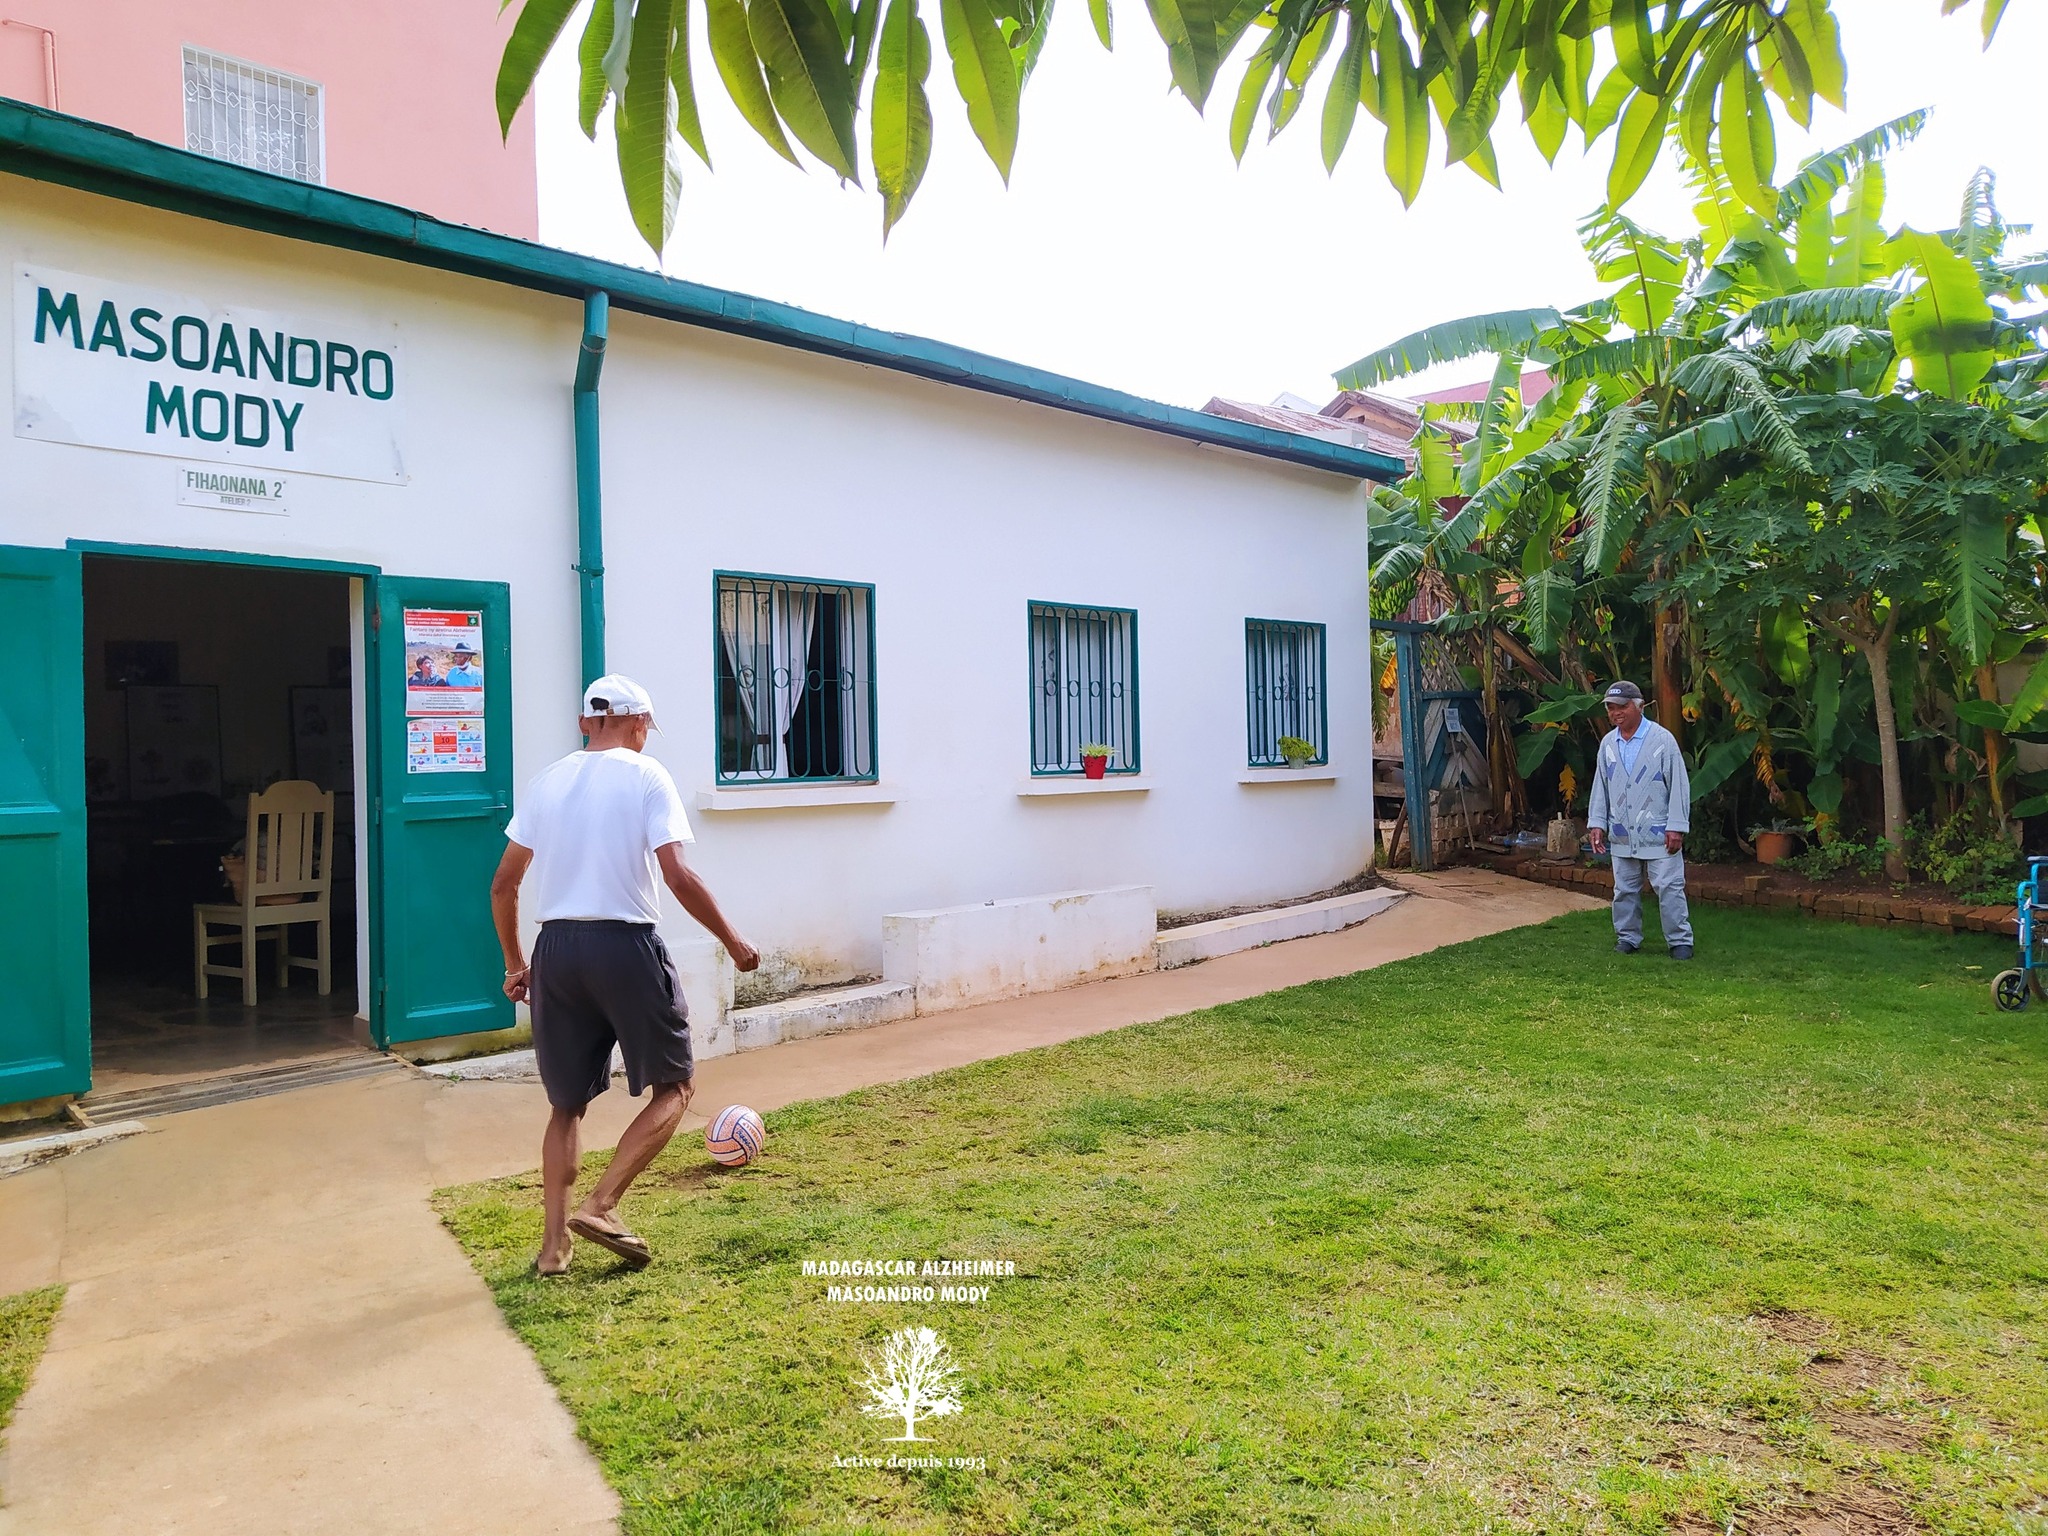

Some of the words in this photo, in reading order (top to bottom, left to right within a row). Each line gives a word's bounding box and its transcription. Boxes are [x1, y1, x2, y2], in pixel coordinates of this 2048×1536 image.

[34, 286, 394, 401] MASOANDRO
[145, 380, 305, 452] MODY
[187, 471, 267, 497] FIHAONANA
[274, 481, 283, 498] 2
[220, 496, 246, 506] ATELIER
[246, 498, 252, 506] 2
